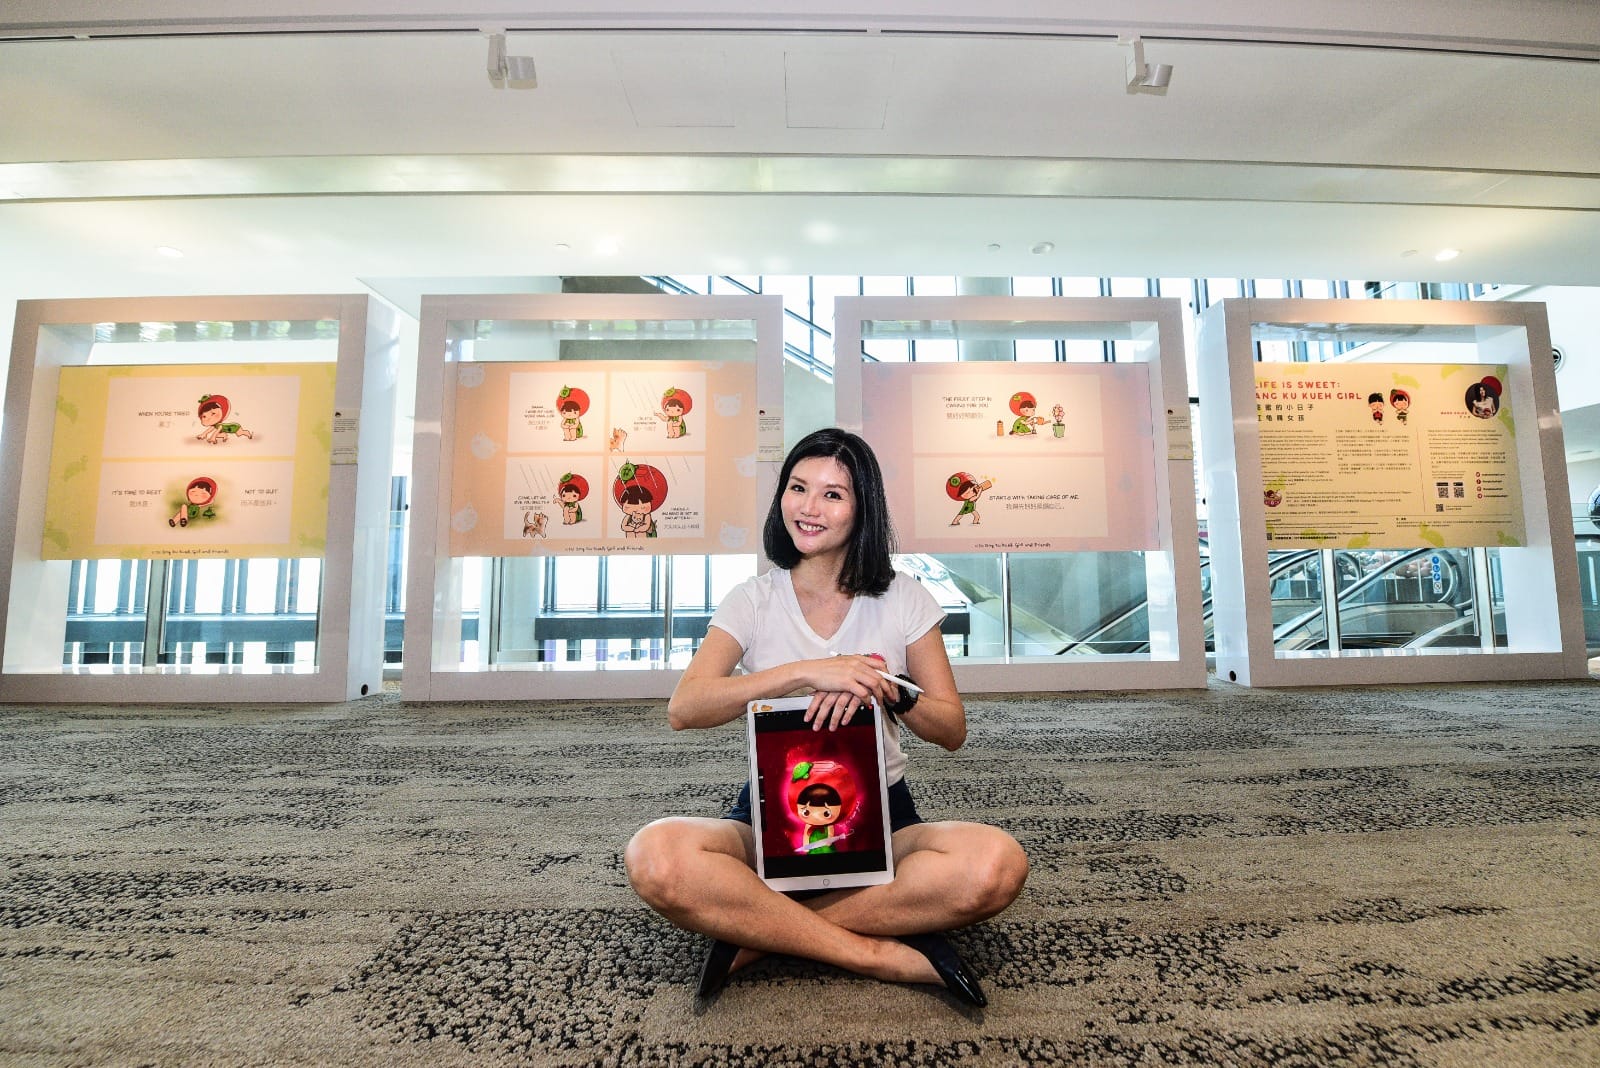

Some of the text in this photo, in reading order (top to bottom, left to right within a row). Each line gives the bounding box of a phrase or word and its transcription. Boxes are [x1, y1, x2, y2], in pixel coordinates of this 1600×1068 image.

[1282, 381, 1293, 389] IS
[1297, 381, 1341, 389] SWEET:
[1282, 392, 1297, 400] KU
[1302, 392, 1332, 400] KUEH
[1336, 392, 1362, 400] GIRL
